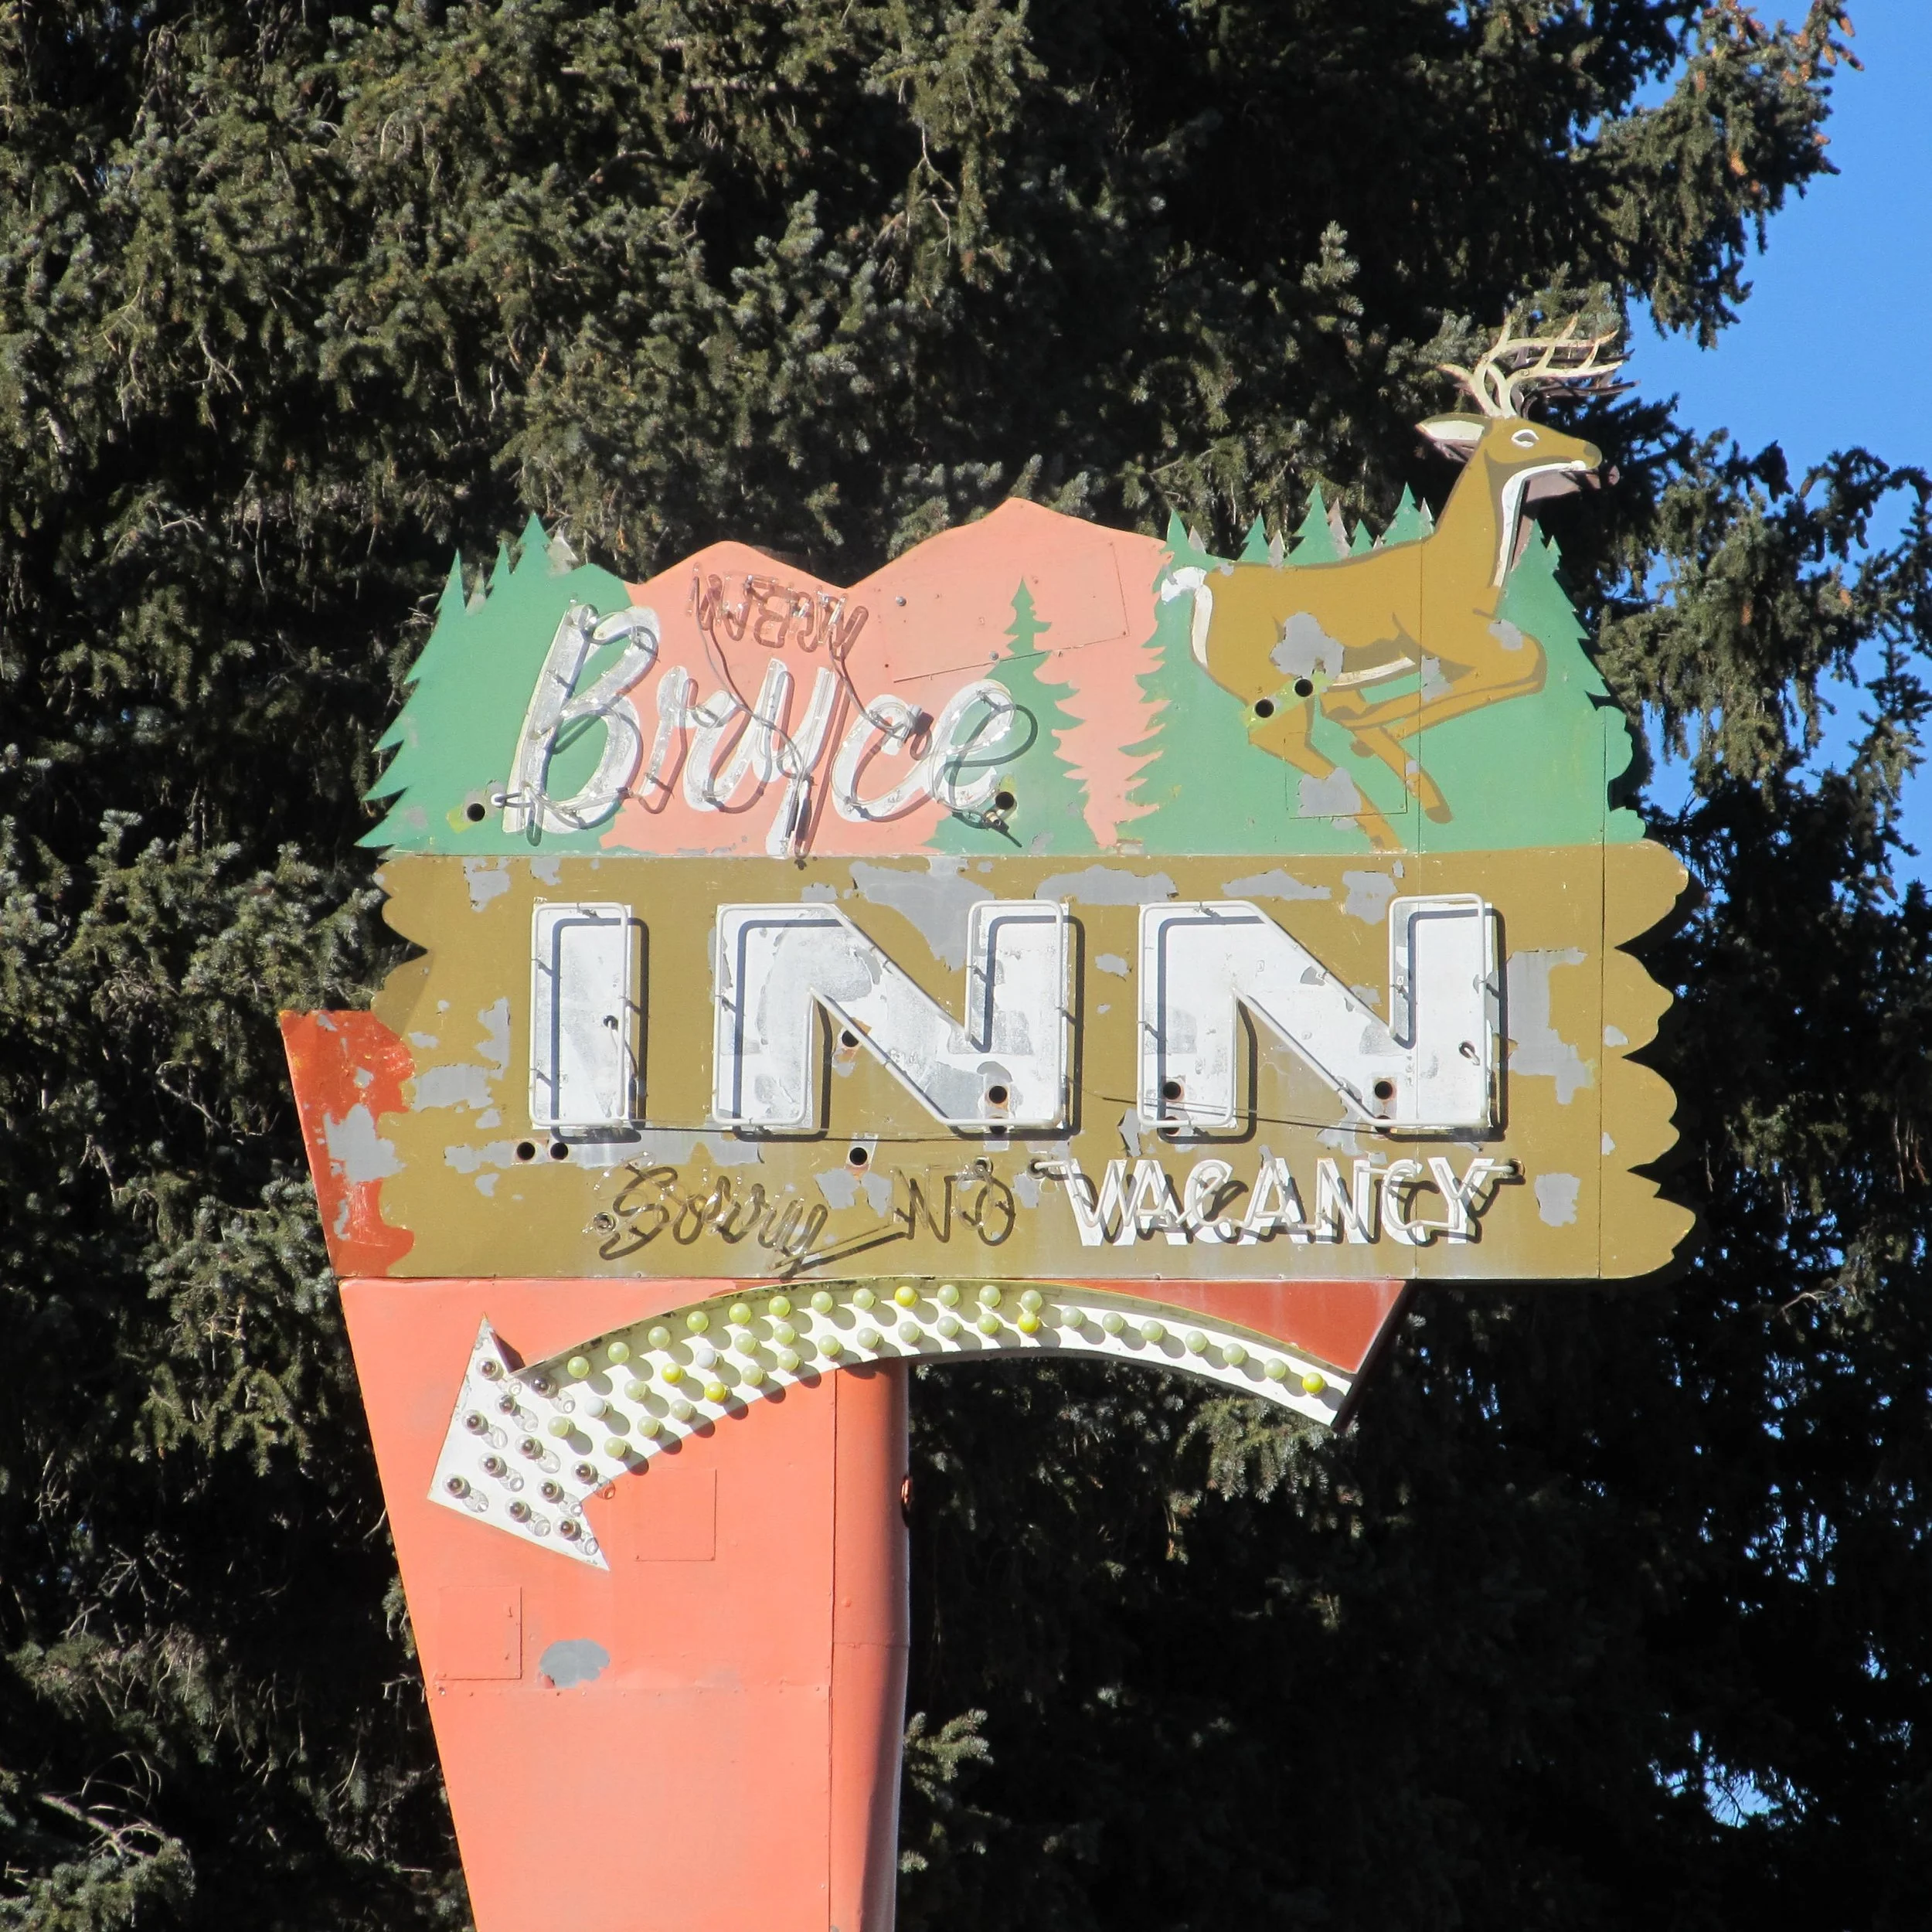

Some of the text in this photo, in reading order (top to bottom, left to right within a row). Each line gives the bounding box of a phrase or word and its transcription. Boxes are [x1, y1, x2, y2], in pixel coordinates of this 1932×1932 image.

[502, 604, 1015, 859] Bryce
[529, 894, 1493, 1131] INN
[585, 1151, 828, 1281] Sorry
[1060, 1156, 1495, 1247] VACANCY
